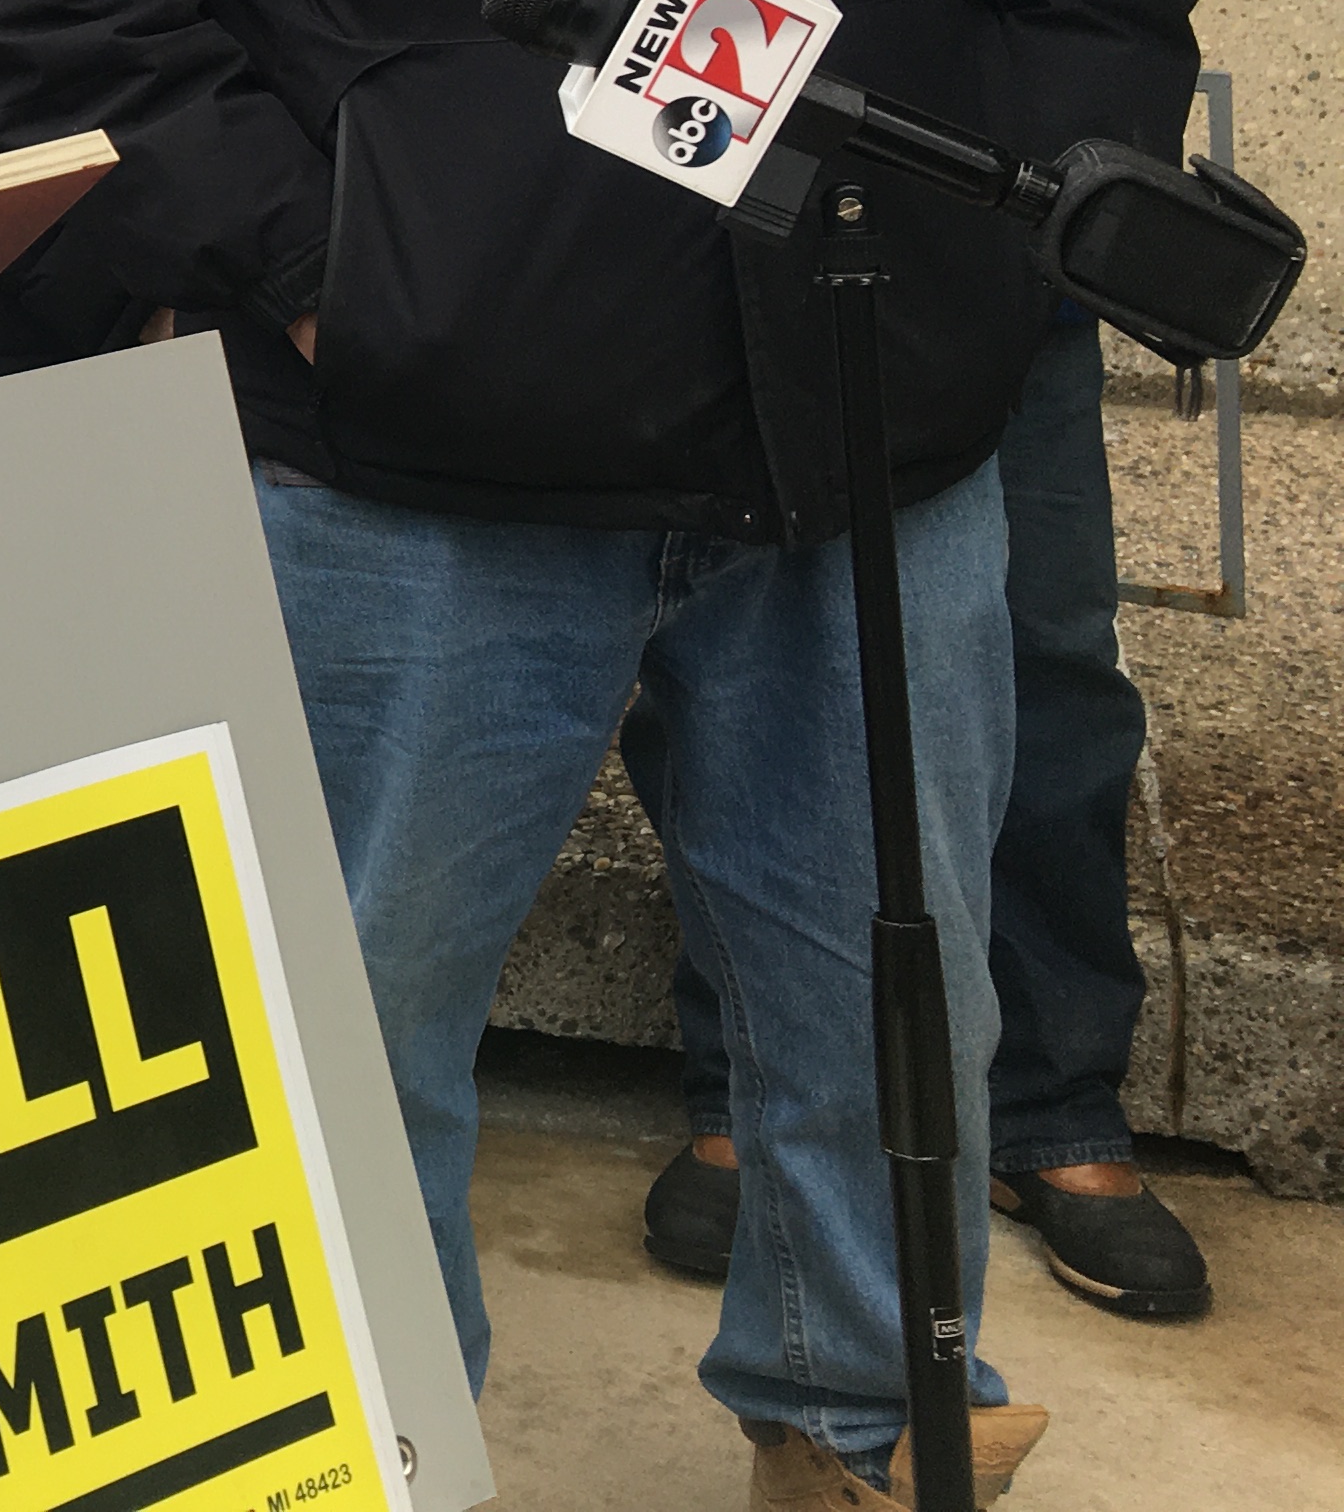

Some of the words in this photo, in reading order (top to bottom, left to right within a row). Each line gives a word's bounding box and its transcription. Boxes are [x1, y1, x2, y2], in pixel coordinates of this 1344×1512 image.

[666, 98, 718, 165] abc
[267, 1488, 291, 1512] MI
[295, 1463, 352, 1502] 48423
